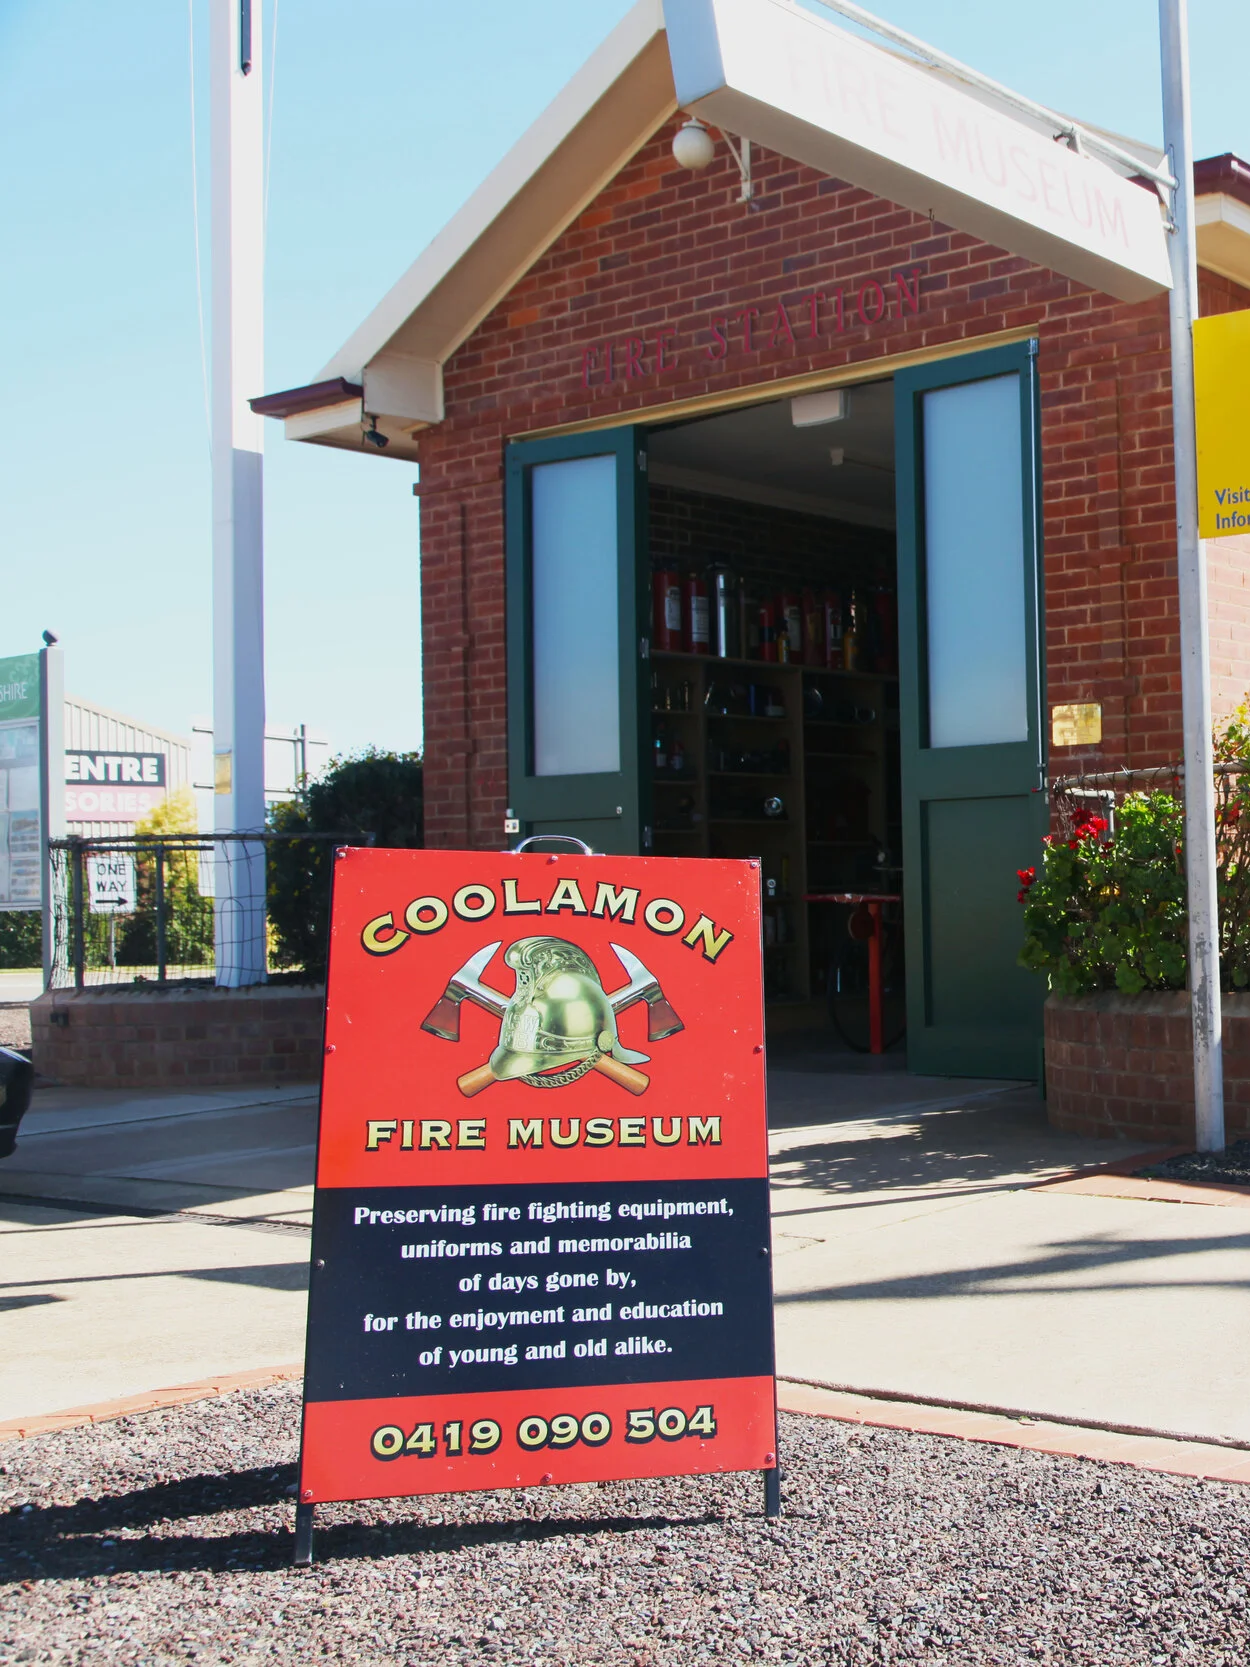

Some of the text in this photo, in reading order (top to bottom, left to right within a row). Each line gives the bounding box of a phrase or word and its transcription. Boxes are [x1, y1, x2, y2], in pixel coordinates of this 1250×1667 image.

[931, 99, 1131, 250] MUSEUM
[580, 268, 921, 389] FIRE STATION
[97, 863, 126, 876] ONE
[96, 881, 127, 892] WAY
[361, 878, 734, 964] COOLAMON
[365, 1115, 722, 1152] FIRE MUSEUM
[354, 1198, 734, 1226] Preserving fire fighting equipment,
[401, 1232, 693, 1259] uniforms and memorabilia
[458, 1268, 637, 1294] of days gone by,
[363, 1299, 724, 1332] for the enjoyment and education
[418, 1336, 673, 1368] of young and old alike.
[370, 1405, 717, 1462] 0419 090 504
